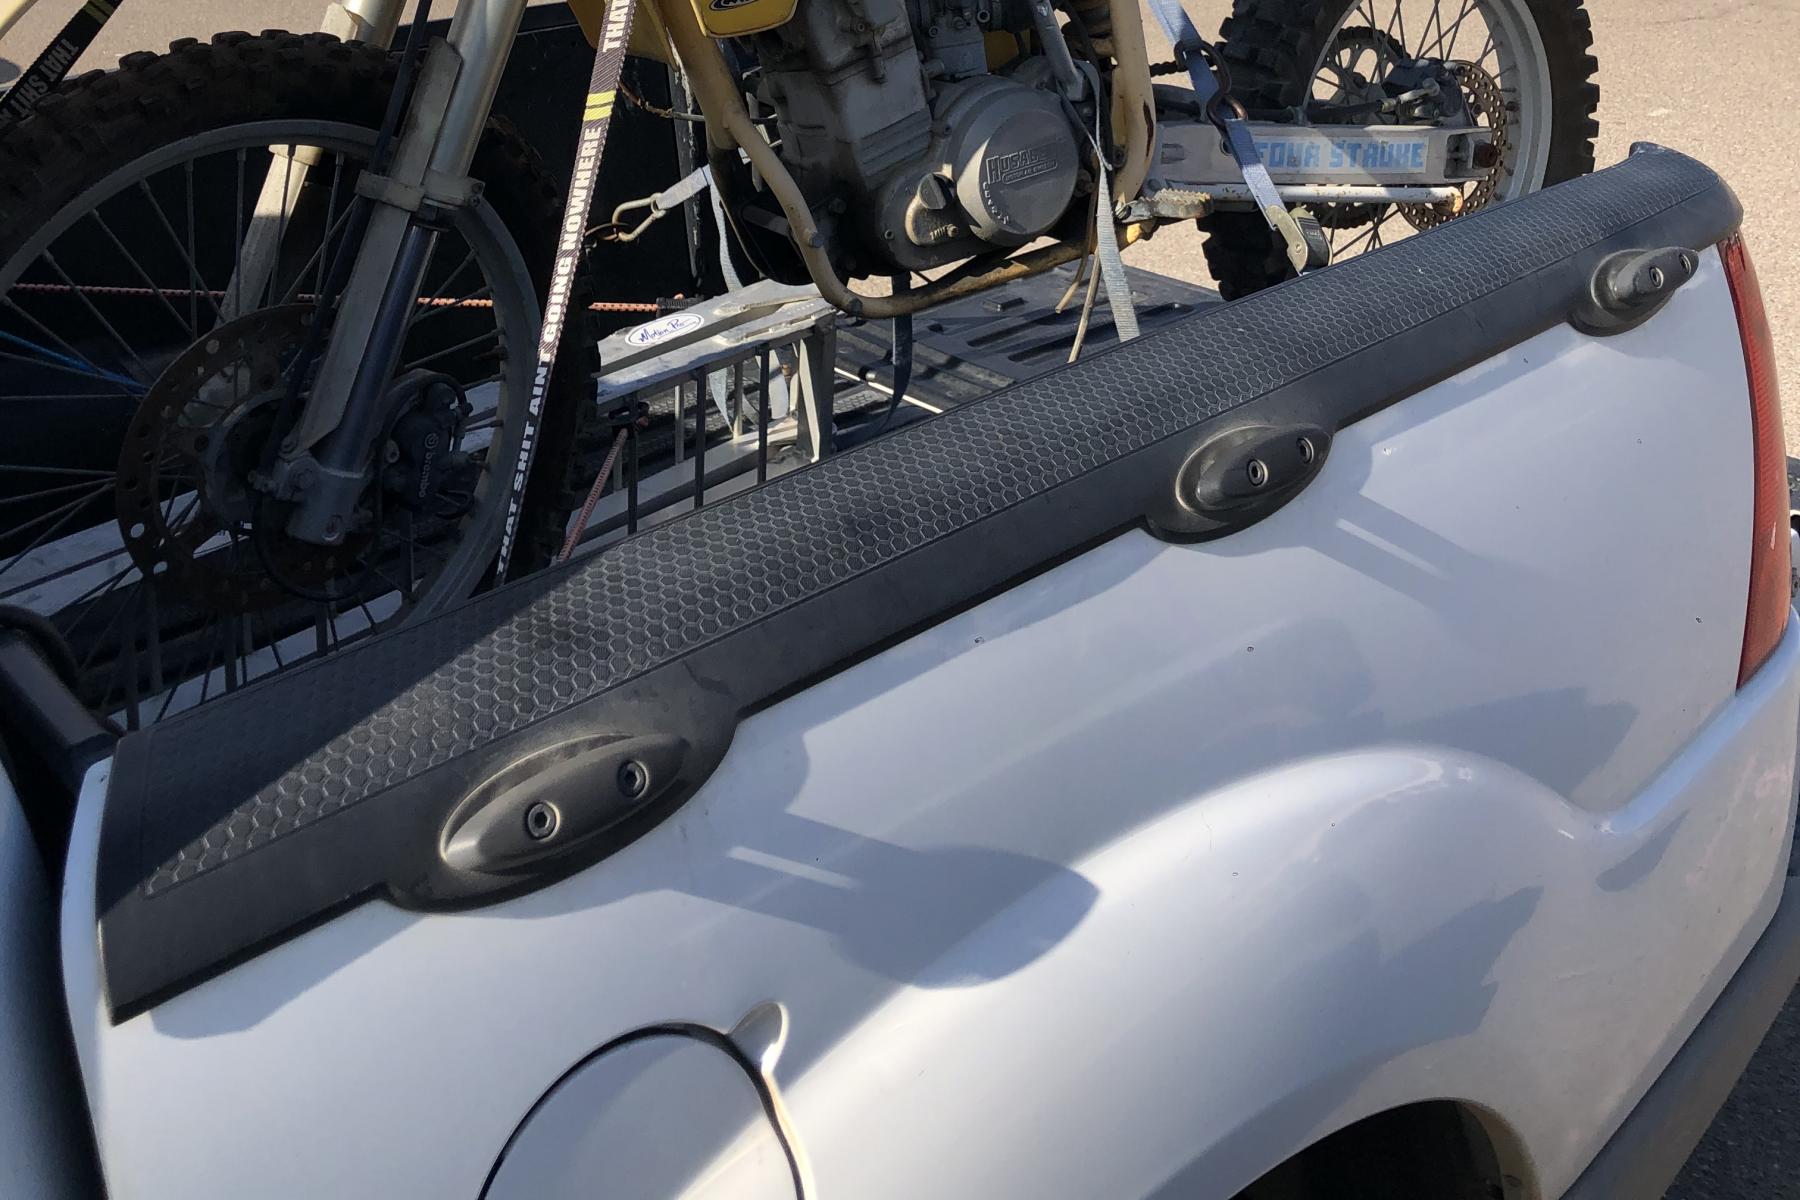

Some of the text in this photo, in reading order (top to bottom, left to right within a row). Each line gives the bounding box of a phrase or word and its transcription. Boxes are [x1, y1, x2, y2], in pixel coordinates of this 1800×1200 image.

[44, 38, 80, 83] THAT
[496, 126, 602, 576] THAT SHIT AINT GOING NOWHERE
